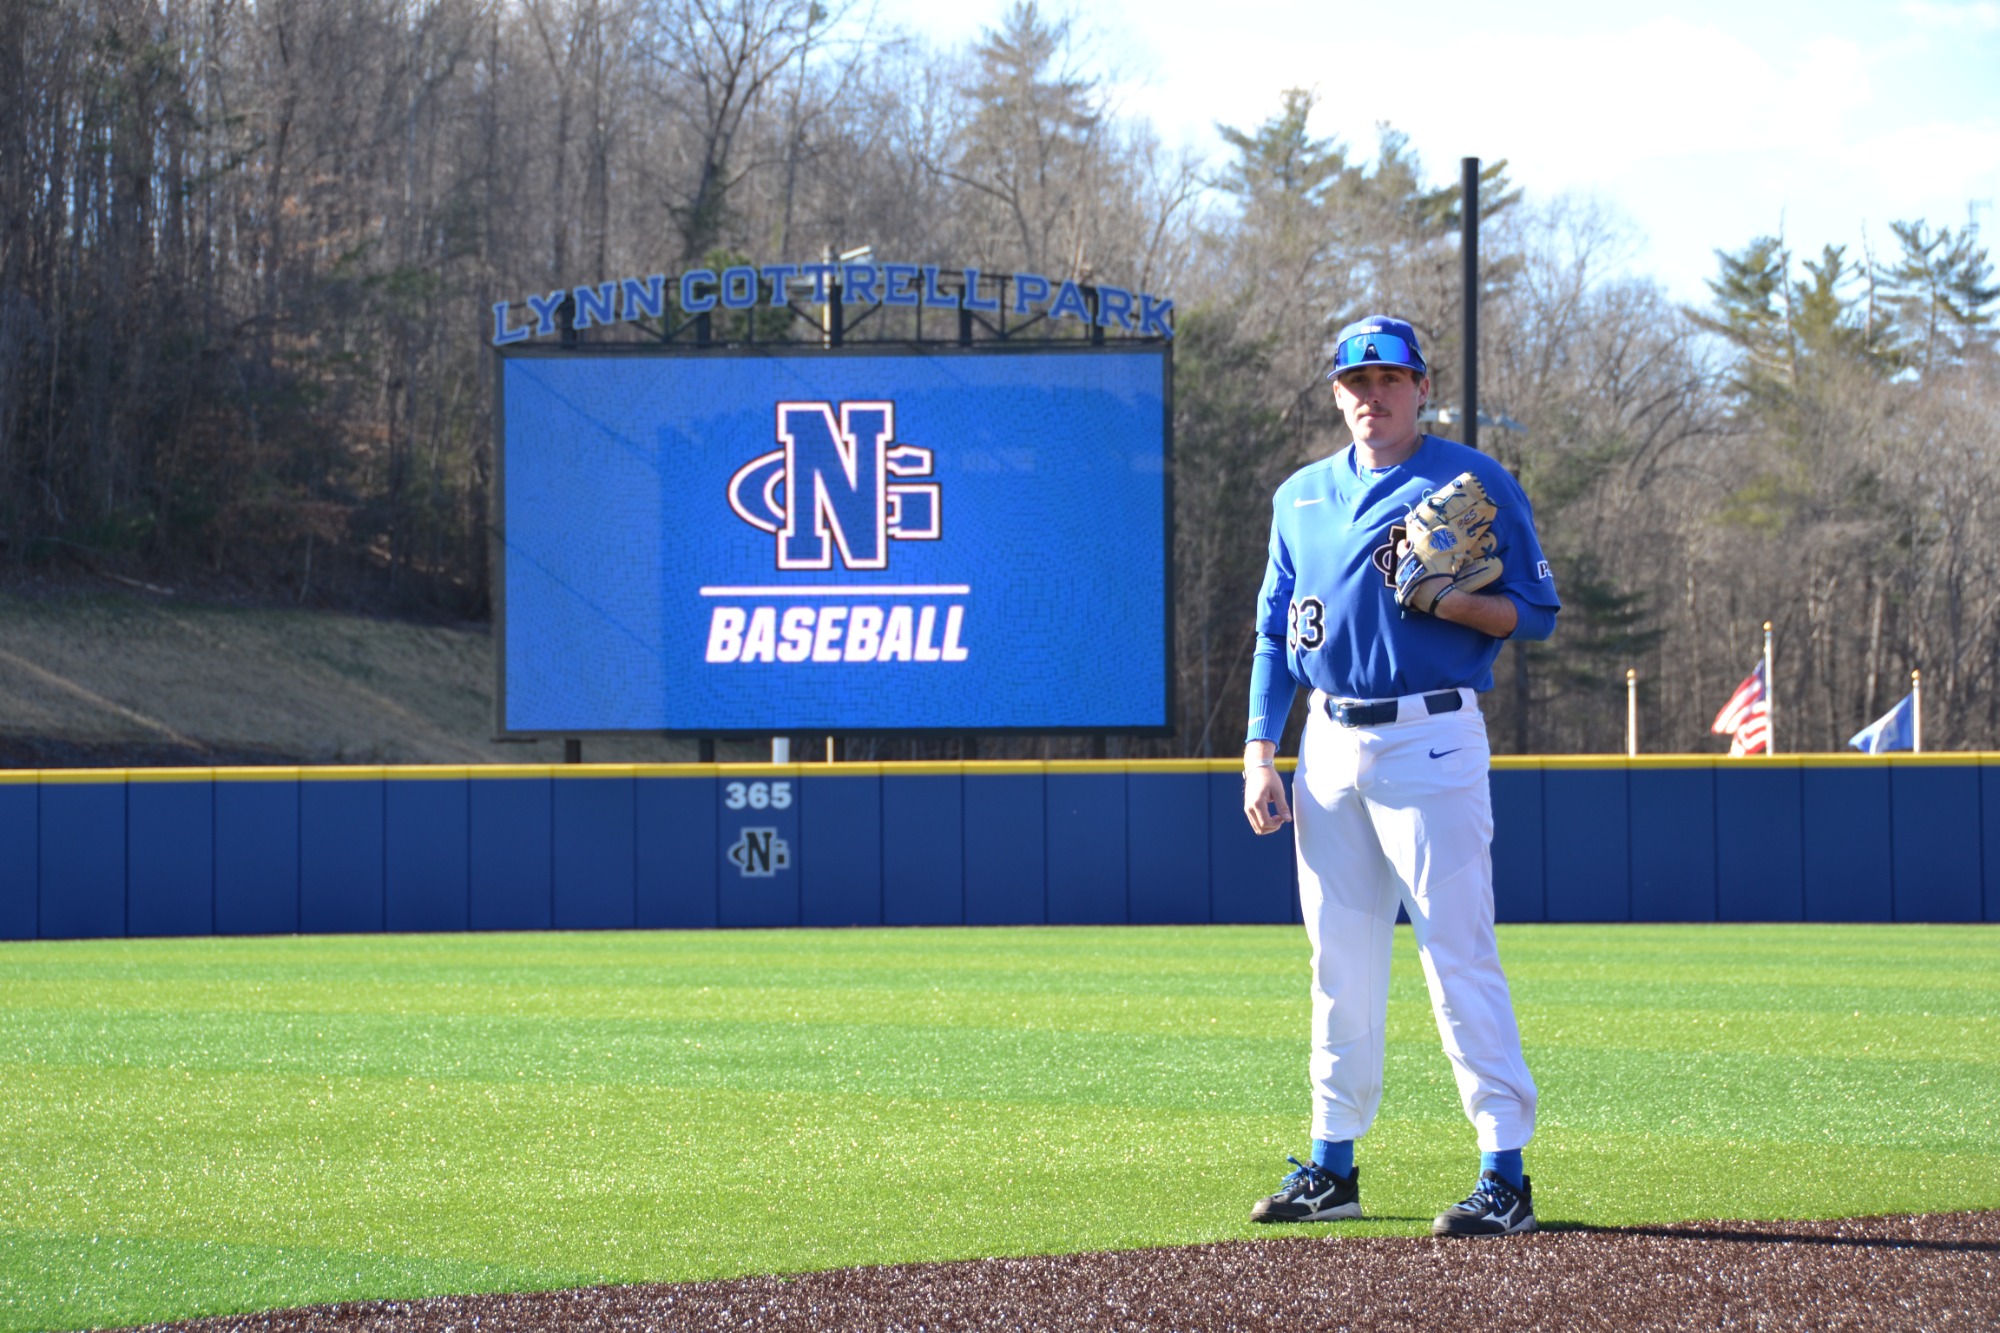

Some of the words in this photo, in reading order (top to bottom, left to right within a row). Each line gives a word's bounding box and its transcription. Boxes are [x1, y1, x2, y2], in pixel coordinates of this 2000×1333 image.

[492, 274, 665, 346] LYNN
[680, 262, 998, 313] COTTRELL
[1013, 272, 1175, 341] PARK
[705, 605, 969, 663] BASEBALL
[725, 781, 792, 810] 365
